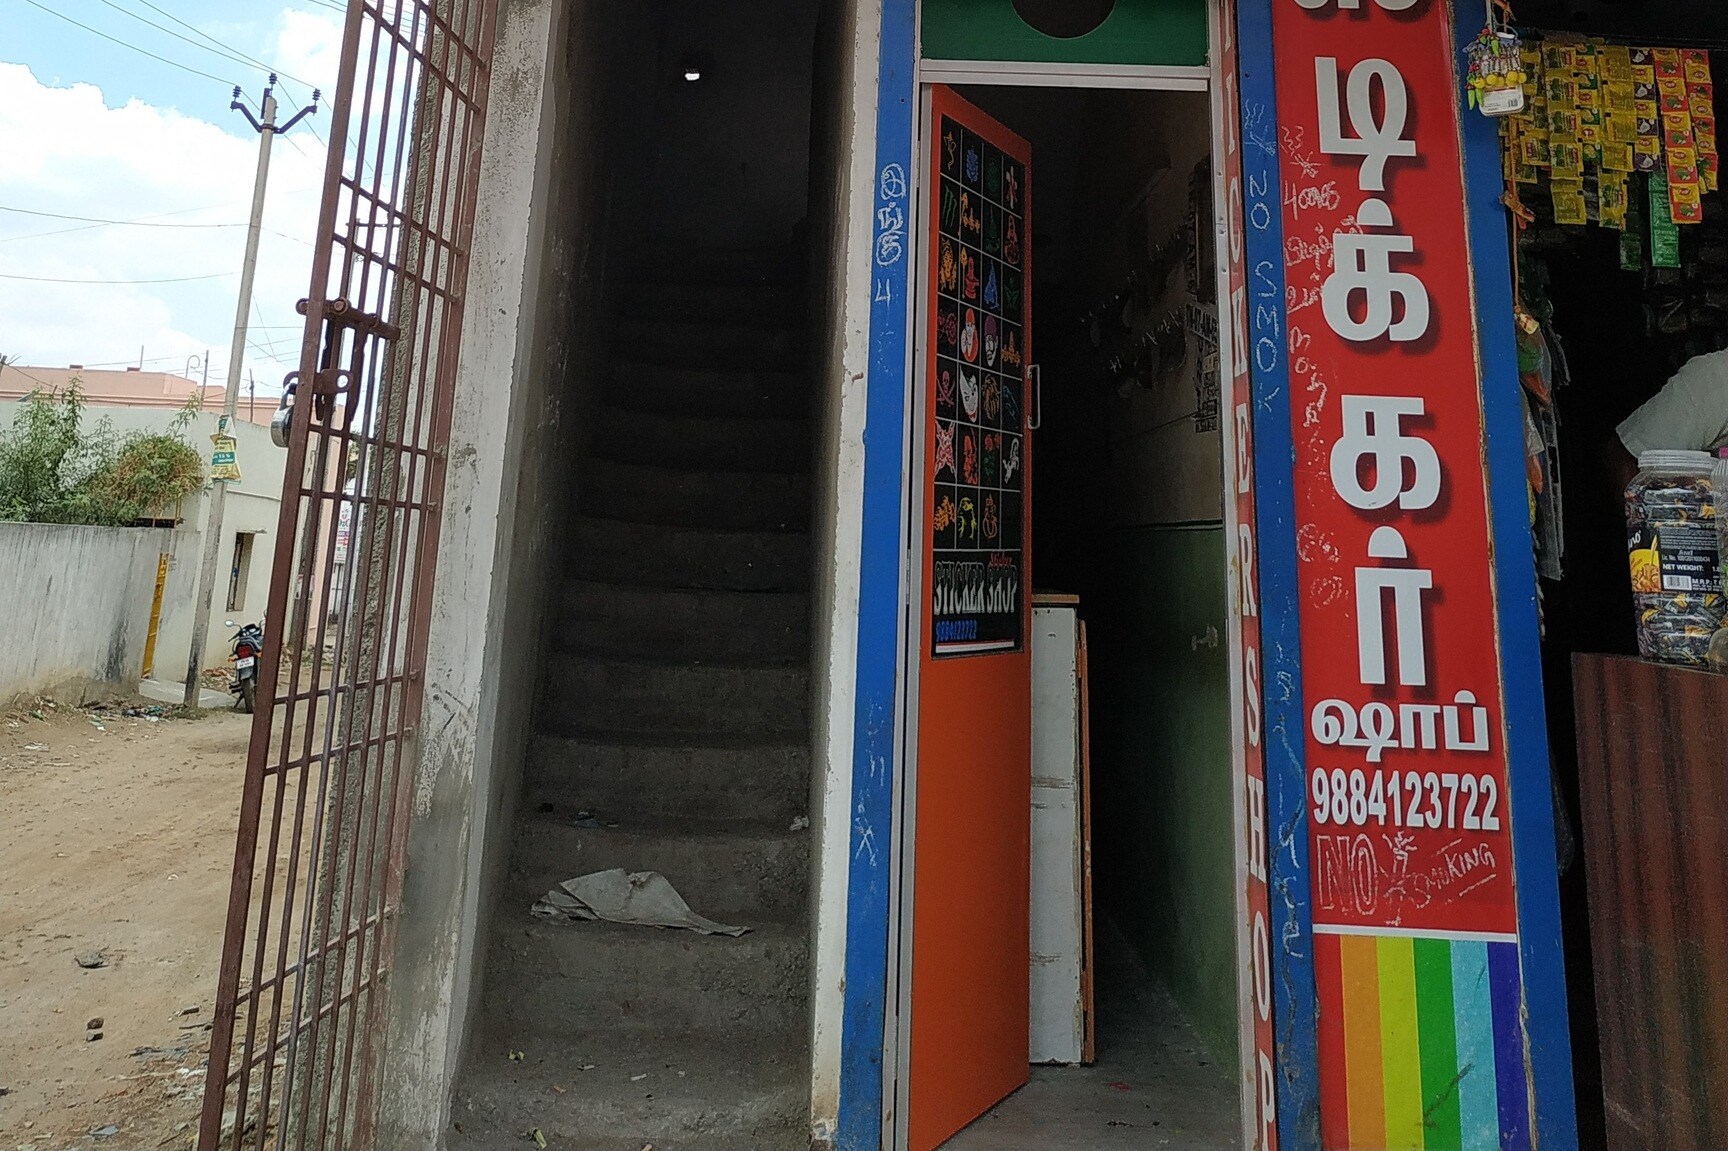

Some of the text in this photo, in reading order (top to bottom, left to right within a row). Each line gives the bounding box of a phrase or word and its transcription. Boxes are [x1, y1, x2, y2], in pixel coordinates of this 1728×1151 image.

[1250, 169, 1271, 230] NO
[1311, 690, 1490, 763] ஷாப்
[1312, 767, 1500, 831] 9884123722
[1317, 833, 1379, 916] NO
